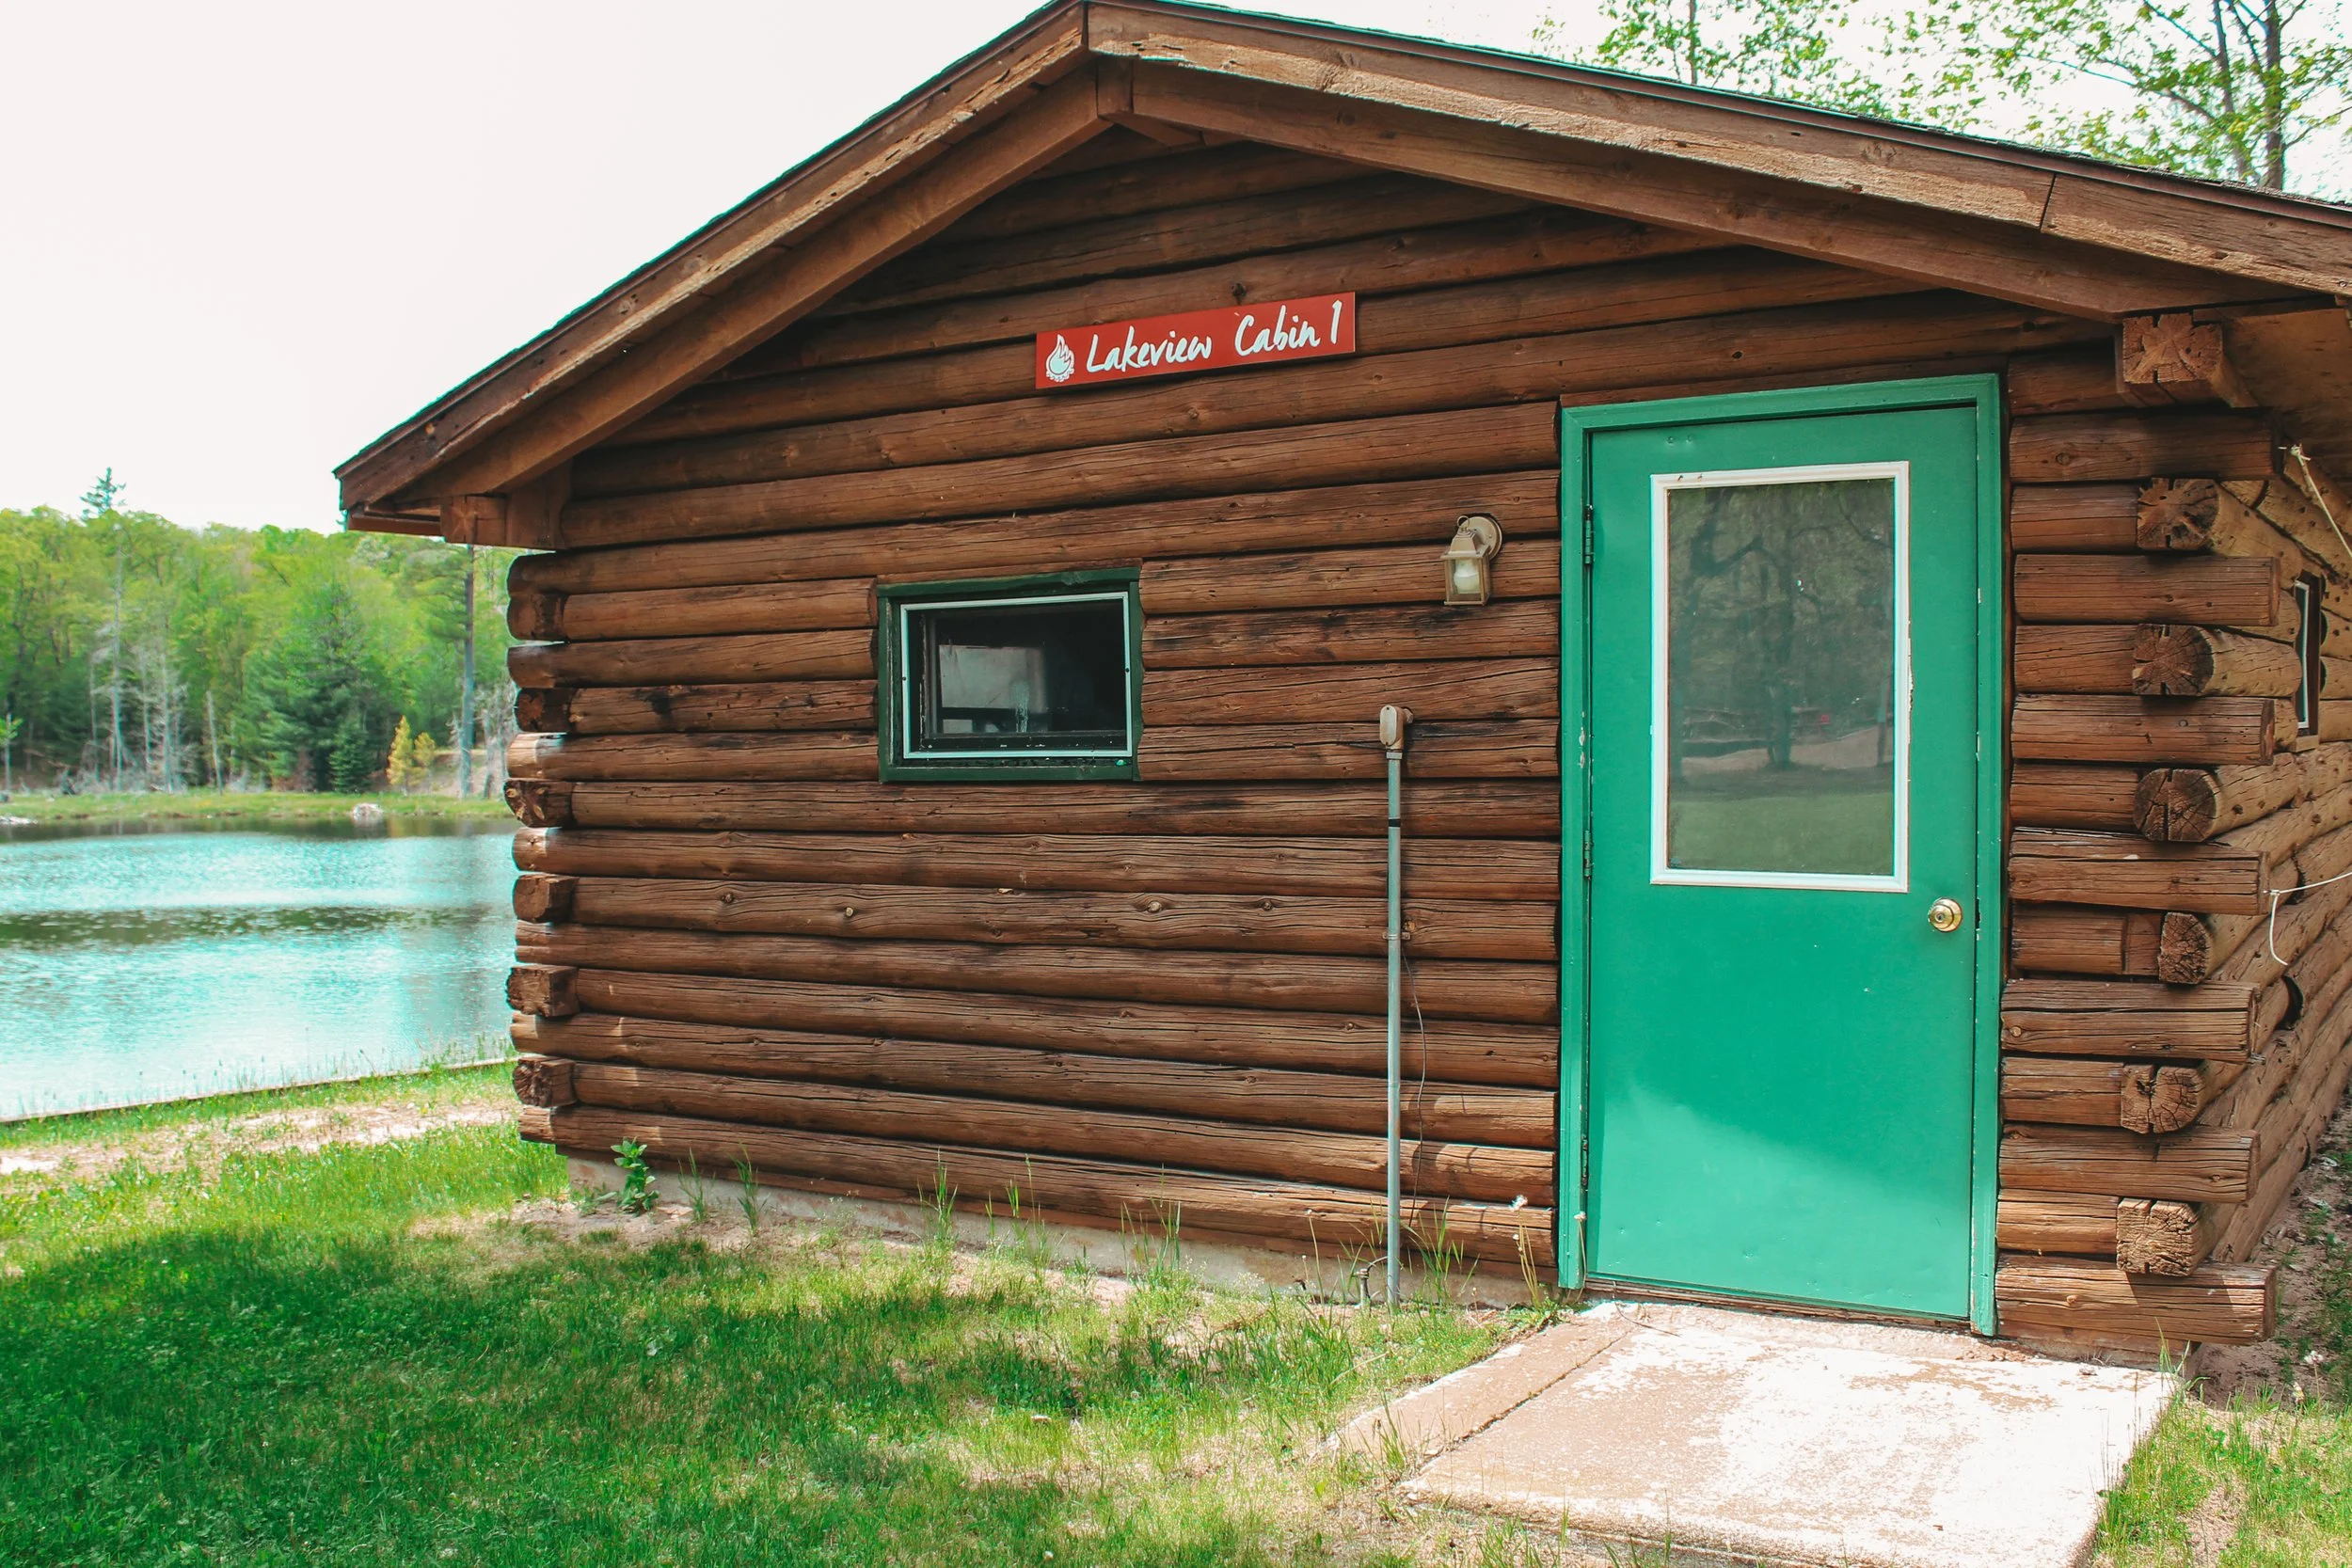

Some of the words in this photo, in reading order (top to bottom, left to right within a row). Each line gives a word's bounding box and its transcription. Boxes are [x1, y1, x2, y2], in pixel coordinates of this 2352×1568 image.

[1086, 325, 1213, 373] Lakeview
[1234, 305, 1321, 356] Cabin
[1330, 300, 1343, 344] 1
